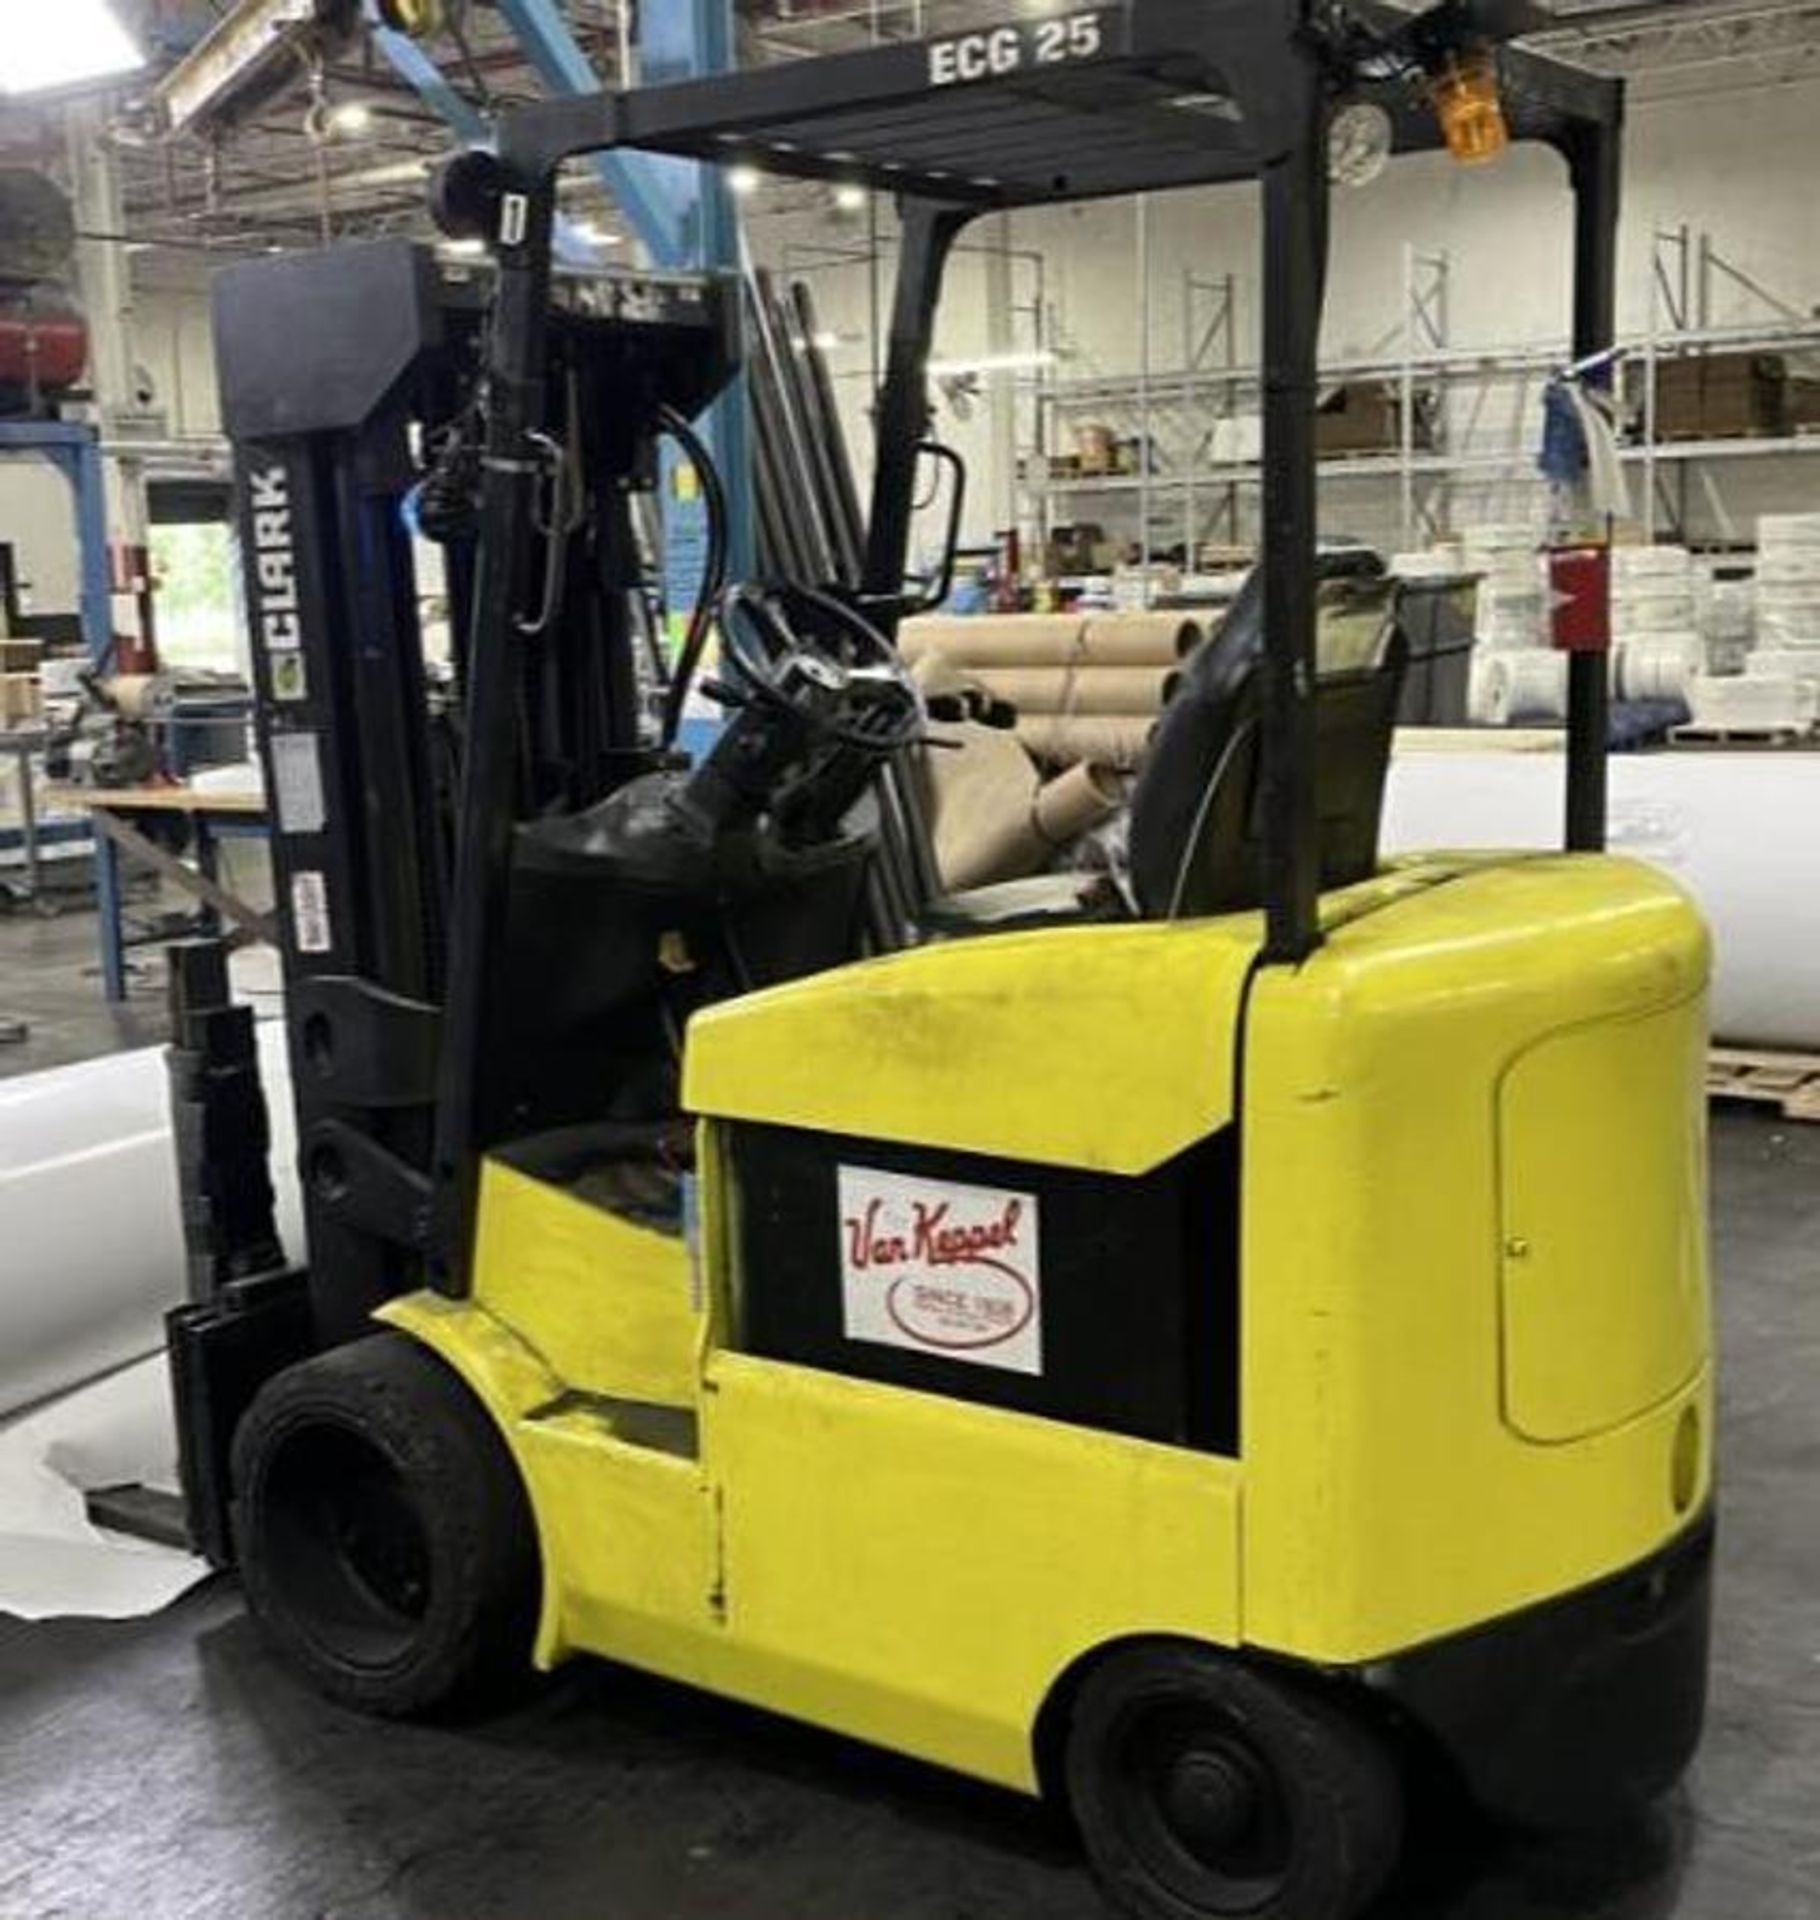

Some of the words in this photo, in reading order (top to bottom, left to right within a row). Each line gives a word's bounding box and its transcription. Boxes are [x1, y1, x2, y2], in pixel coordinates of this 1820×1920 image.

[929, 27, 1020, 85] ECG
[1034, 14, 1101, 63] 25
[250, 466, 301, 649] CLARK
[844, 1198, 908, 1269] Van
[912, 1198, 1021, 1266] Keppel
